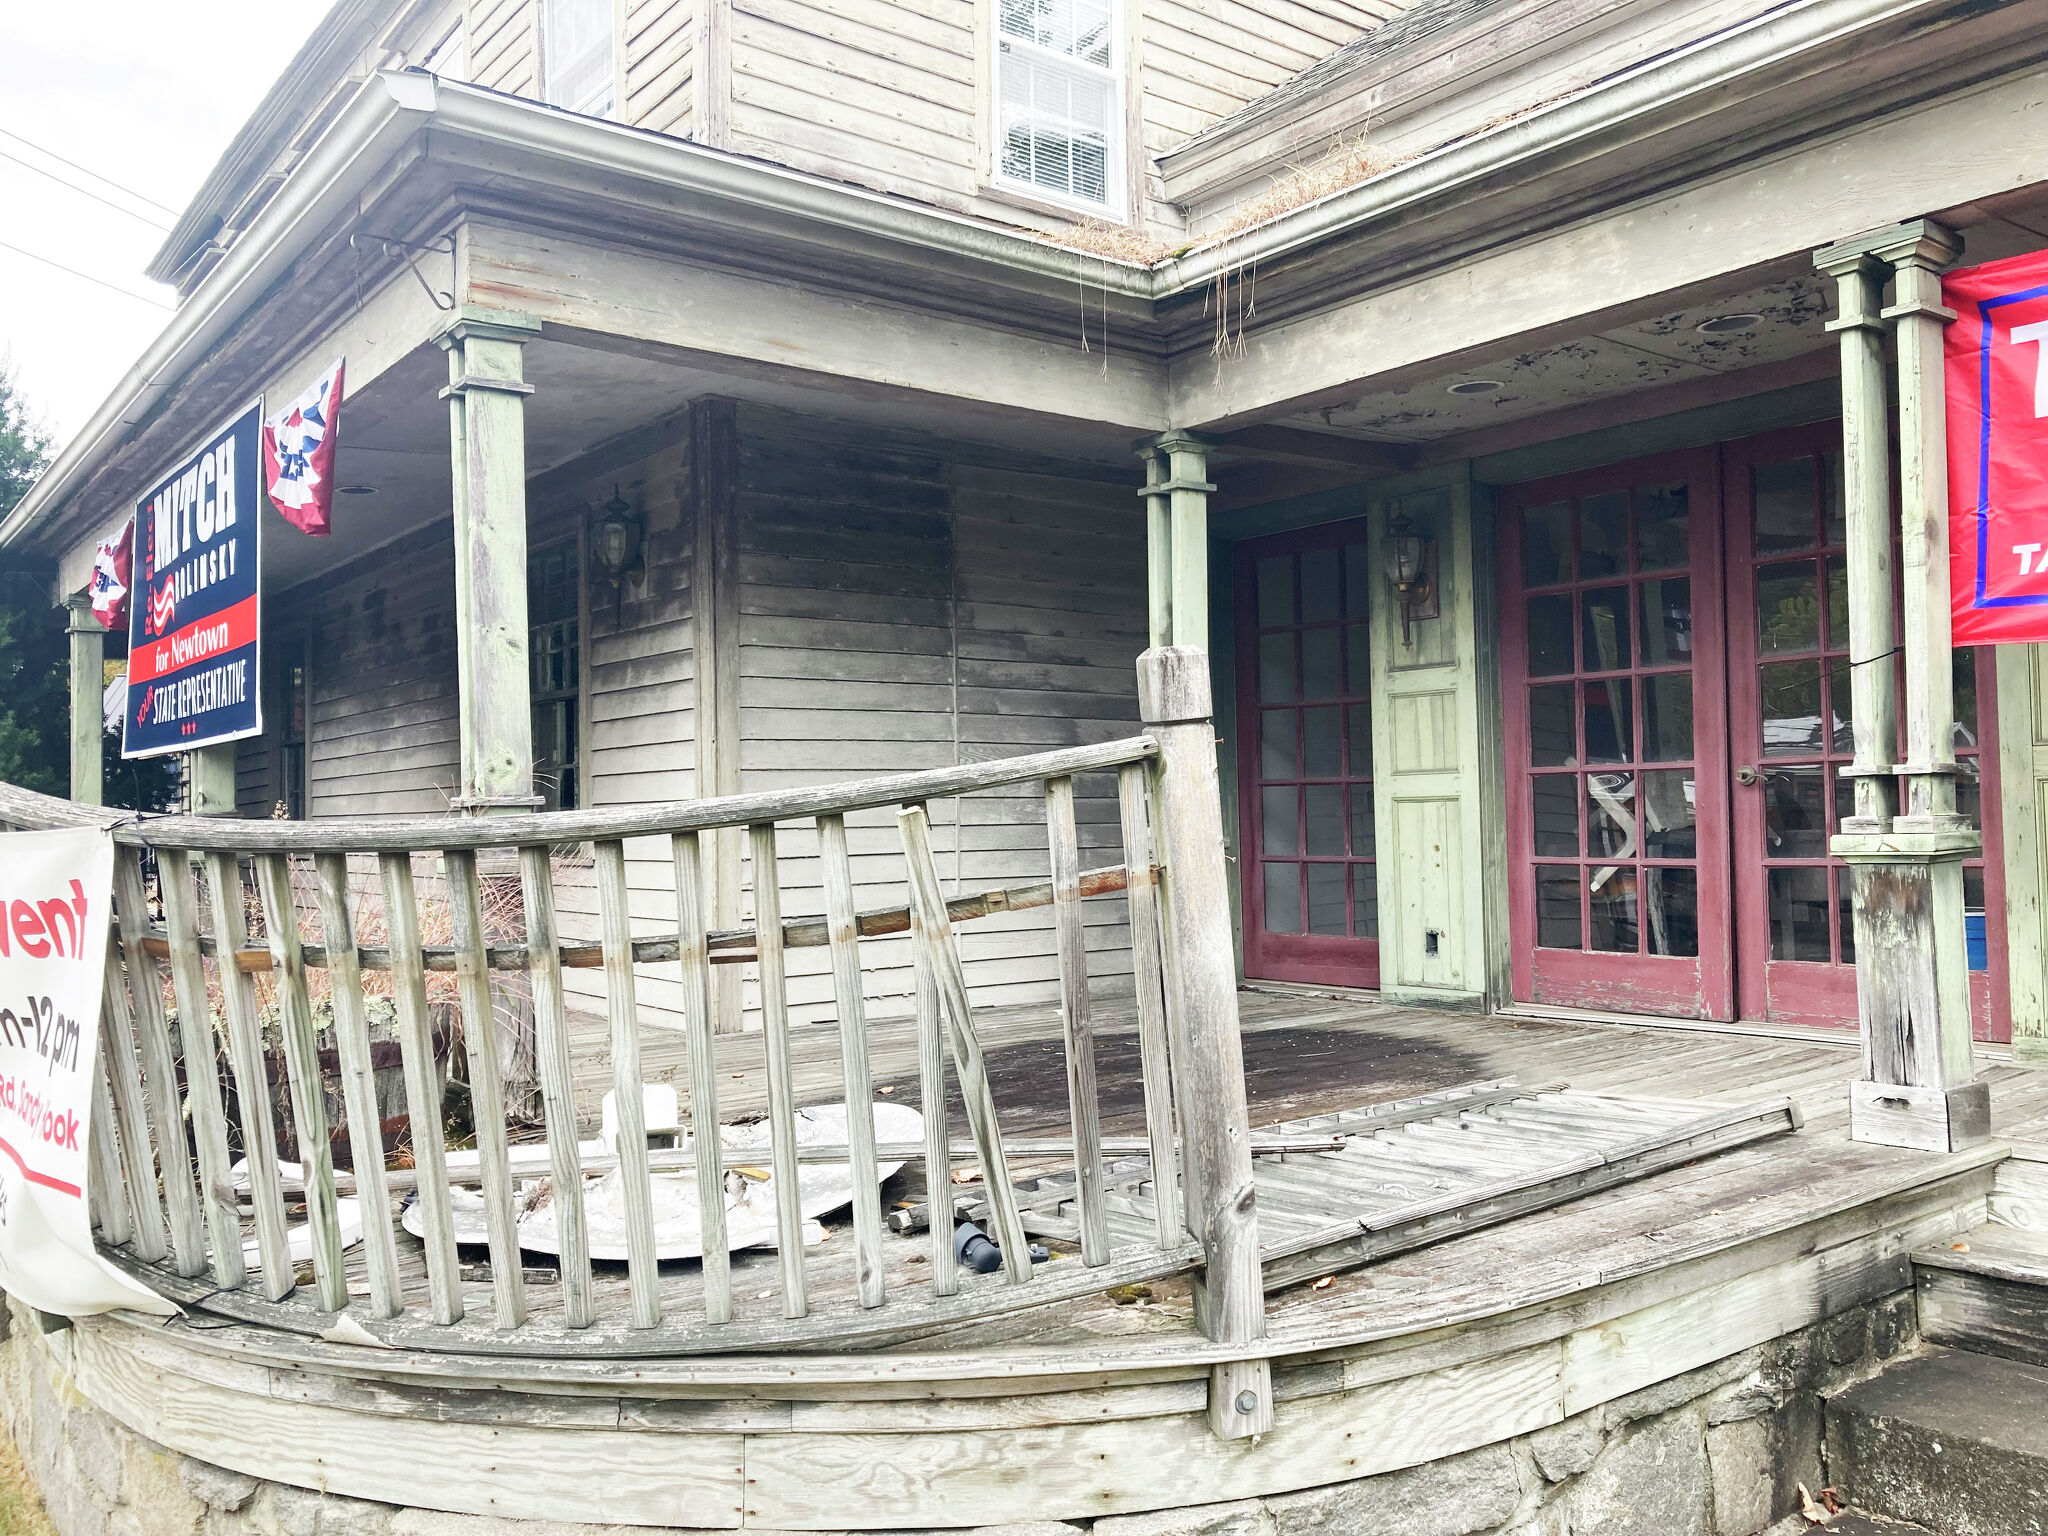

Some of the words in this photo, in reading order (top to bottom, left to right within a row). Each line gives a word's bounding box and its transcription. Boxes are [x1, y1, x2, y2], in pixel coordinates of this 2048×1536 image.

[153, 433, 237, 574] MITCH
[174, 537, 236, 604] BOLINSKY
[155, 646, 169, 673] for
[171, 622, 229, 667] Newtown
[136, 685, 154, 729] YOUR
[153, 683, 177, 725] STATE
[177, 659, 247, 719] REPRESENTATIVE
